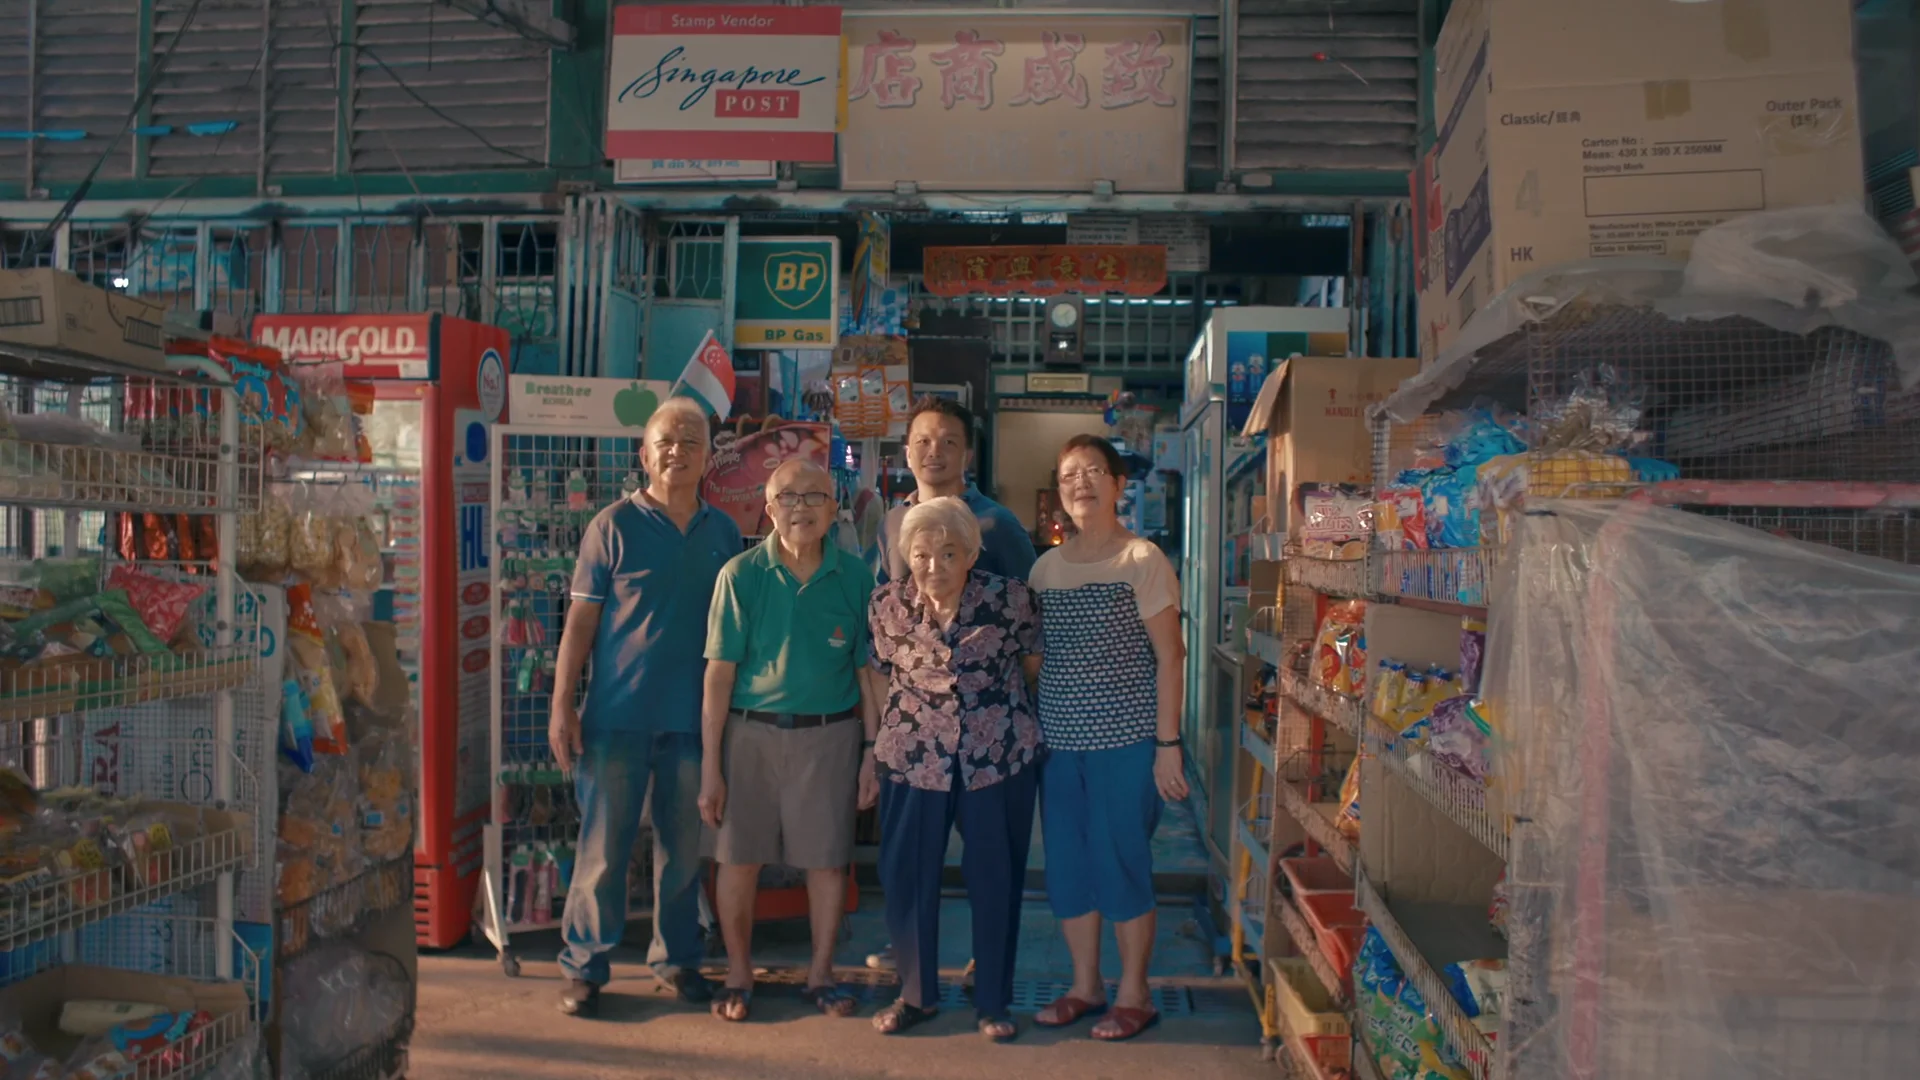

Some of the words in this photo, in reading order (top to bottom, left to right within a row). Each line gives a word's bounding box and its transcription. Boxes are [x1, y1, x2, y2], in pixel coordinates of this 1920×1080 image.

[671, 13, 716, 29] Stamp
[720, 14, 774, 28] Vendor
[619, 46, 826, 110] Singapore
[724, 95, 789, 113] POST
[1766, 100, 1806, 112] Outer
[1810, 97, 1843, 110] Pack
[1582, 138, 1618, 148] Carton
[1640, 148, 1648, 157] X
[1673, 146, 1681, 156] X
[1510, 245, 1534, 262] HK
[774, 261, 820, 292] BP
[764, 329, 789, 342] BP
[794, 328, 824, 343] Gas
[261, 326, 416, 365] MARIGOLD
